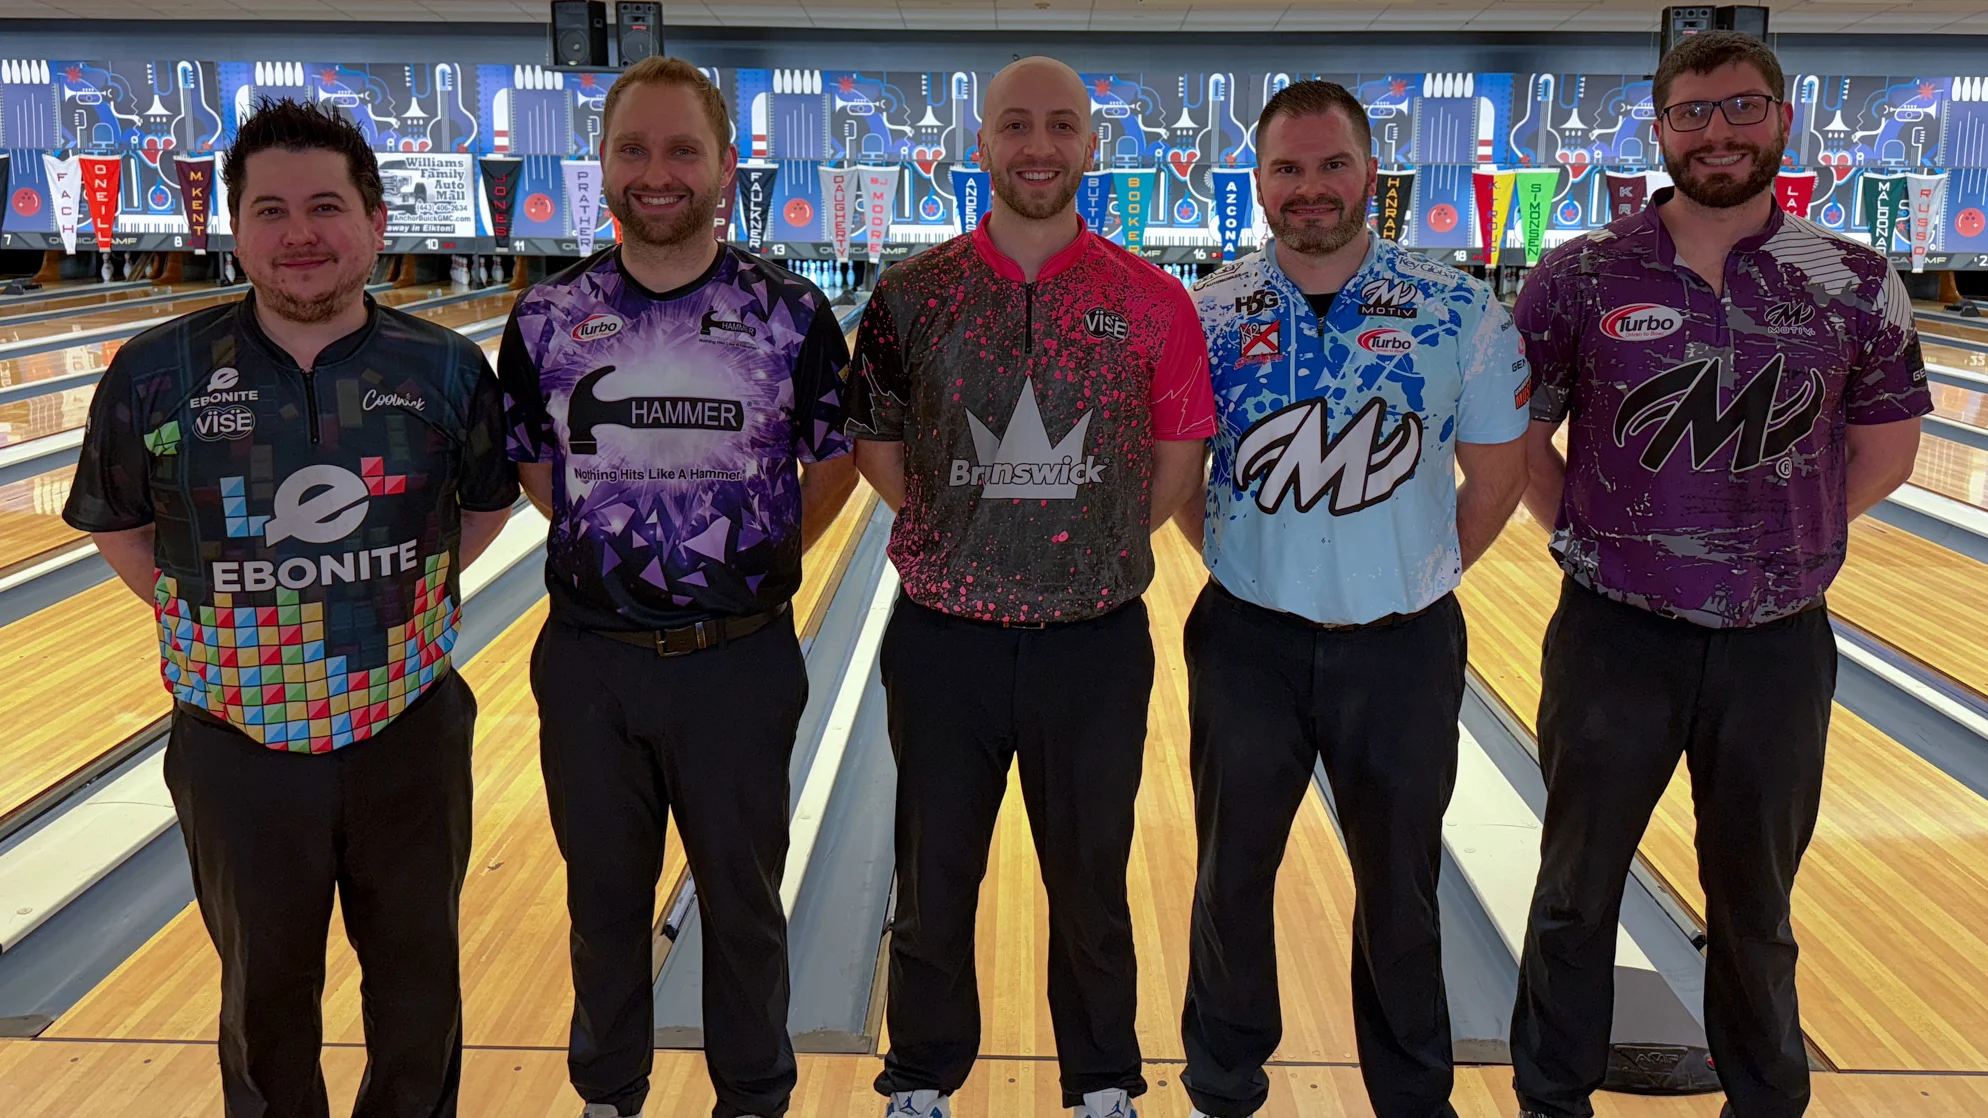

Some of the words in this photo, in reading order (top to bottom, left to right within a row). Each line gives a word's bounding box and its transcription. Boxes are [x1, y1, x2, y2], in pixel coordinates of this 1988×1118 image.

[406, 157, 464, 168] Williams
[420, 168, 465, 181] Family
[435, 180, 465, 190] Auto
[94, 165, 110, 241] ONEILL
[436, 190, 466, 201] Mall
[57, 173, 74, 234] FACH
[416, 204, 435, 212] (443)
[494, 174, 507, 237] JONES
[577, 171, 591, 247] PRATHER
[748, 172, 763, 249] FAULKNER
[192, 187, 204, 236] KENT
[394, 214, 471, 223] AnchorBuickGMC.com
[833, 175, 847, 257] DAUGHERTY
[1223, 181, 1238, 252] AZCONA
[869, 191, 885, 253] MOORE
[1486, 198, 1498, 255] TROUP
[1527, 183, 1542, 257] SIMONSEN
[1913, 188, 1932, 256] RUSSO
[387, 225, 409, 233] away
[412, 224, 420, 232] in
[422, 224, 454, 232] Elkton!
[4, 234, 12, 246] 7
[174, 236, 183, 247] 8
[425, 238, 439, 250] 10
[514, 240, 525, 251] 11
[772, 244, 785, 256] 13
[1193, 248, 1207, 260] 16
[1453, 250, 1467, 261] 18
[1361, 306, 1413, 317] MOTIV
[580, 321, 618, 336] Turbo
[722, 322, 755, 335] HAMMER
[1617, 315, 1674, 333] Turbo
[1767, 326, 1813, 336] MOTIV
[1370, 336, 1412, 350] Turbo
[190, 390, 259, 409] EBONITE
[631, 400, 737, 427] HAMMER
[574, 467, 617, 482] Nothing
[620, 468, 644, 480] Hits
[648, 468, 675, 480] Like
[678, 469, 687, 480] A
[690, 469, 742, 481] Hammer.
[949, 455, 1107, 487] Brunswick
[212, 539, 417, 593] EBONITE
